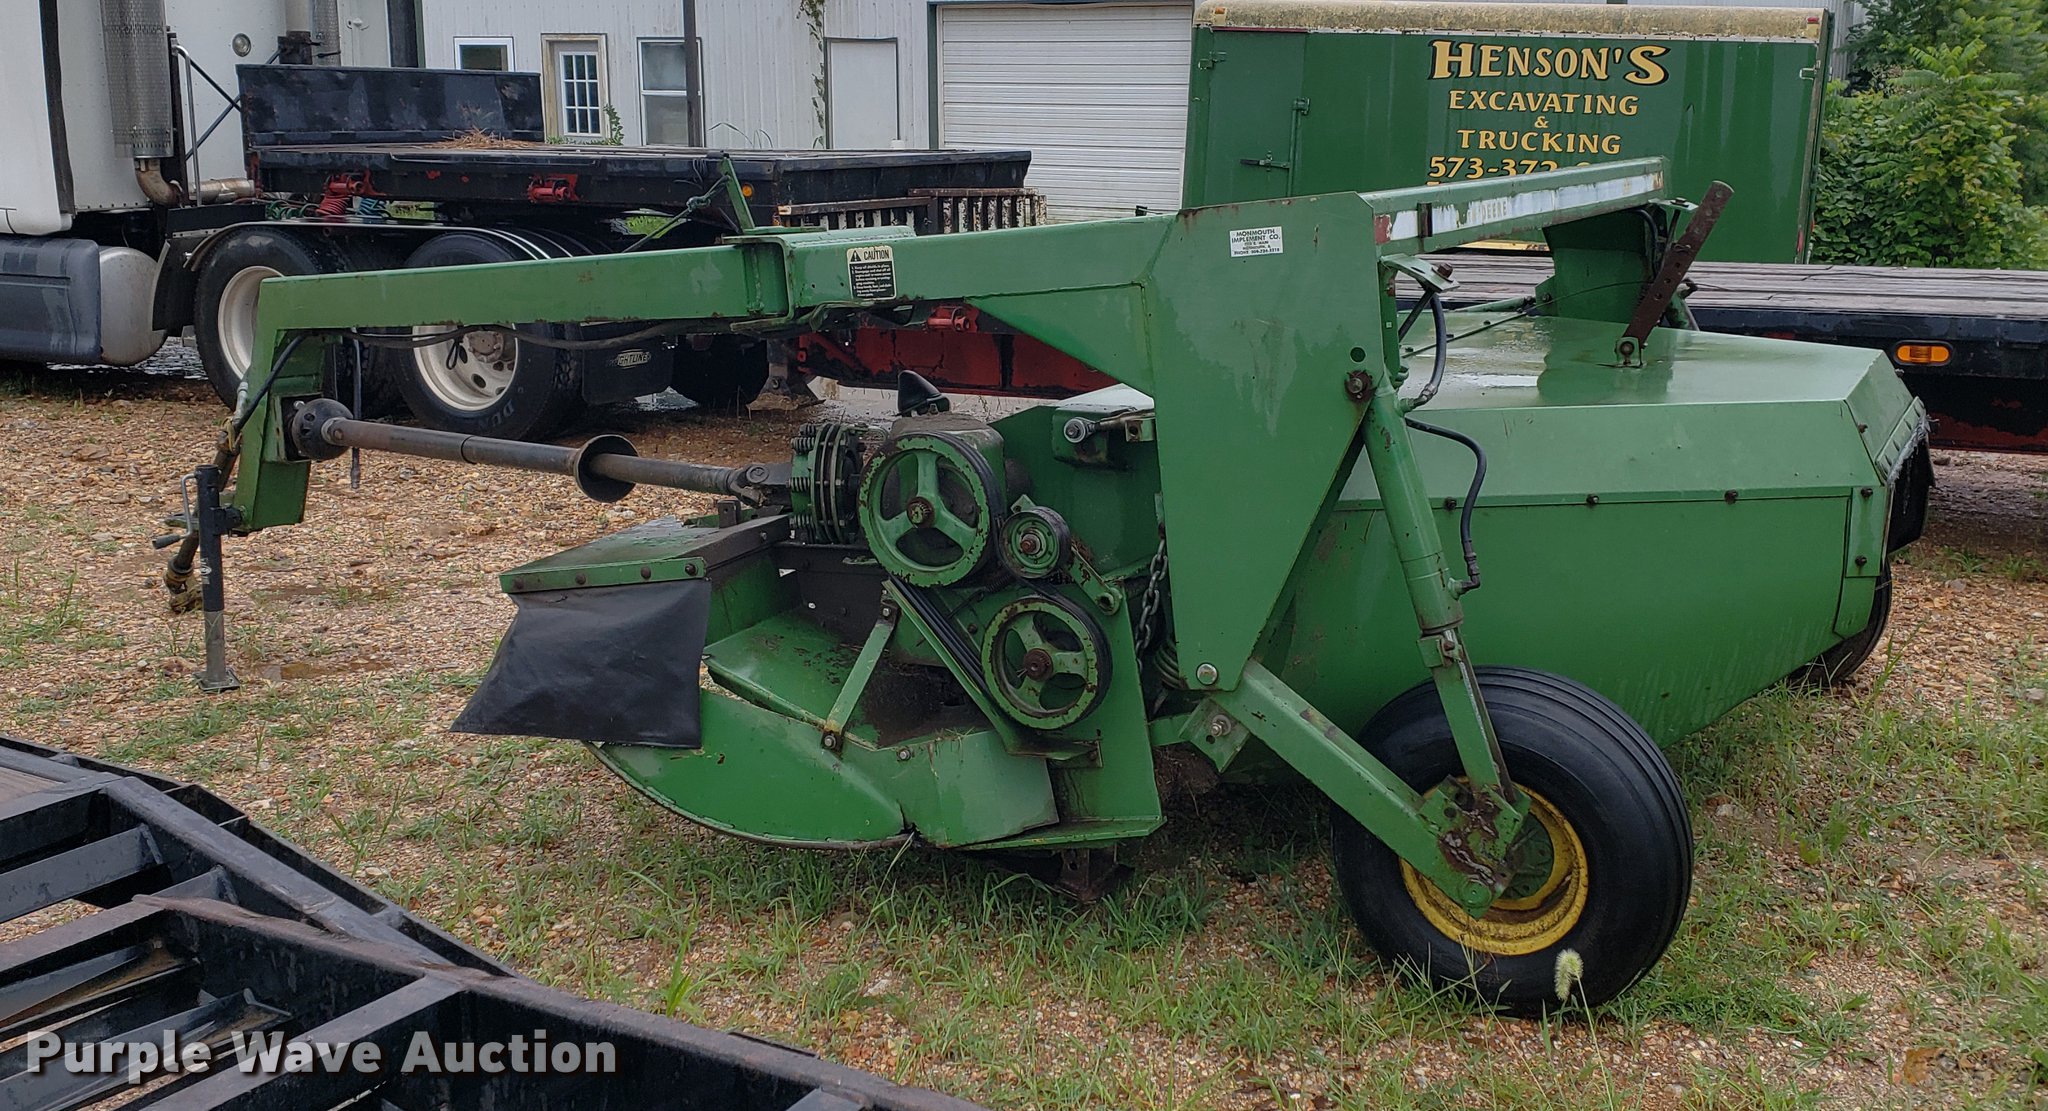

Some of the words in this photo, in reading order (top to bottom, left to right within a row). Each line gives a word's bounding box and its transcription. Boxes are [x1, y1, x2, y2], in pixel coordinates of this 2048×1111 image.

[1430, 40, 1669, 85] HENSON'S
[1449, 90, 1639, 116] EXCAVATING
[1534, 116, 1549, 129] &
[1457, 129, 1622, 155] TRUCKING
[1232, 235, 1266, 243] IMPLEMENT
[1236, 229, 1275, 237] MONMOUTH
[863, 249, 890, 260] CAUTION
